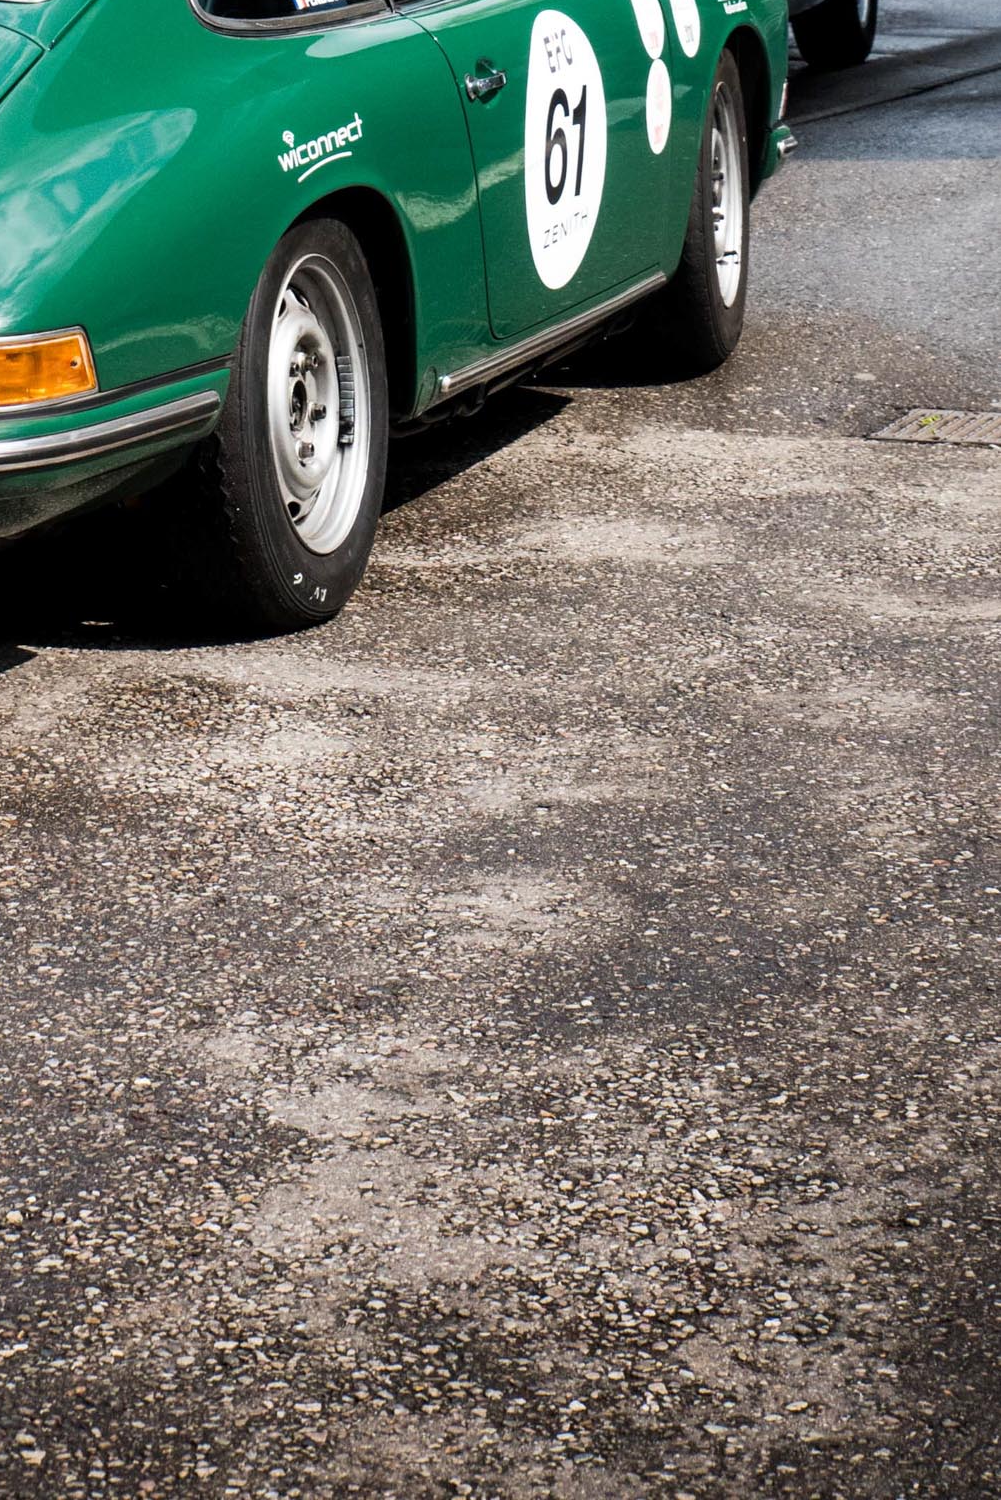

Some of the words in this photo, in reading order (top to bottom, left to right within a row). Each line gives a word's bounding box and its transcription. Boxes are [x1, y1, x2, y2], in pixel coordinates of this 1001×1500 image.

[278, 112, 363, 172] wiconnect
[544, 84, 587, 205] 61
[543, 208, 588, 249] ZENITH
